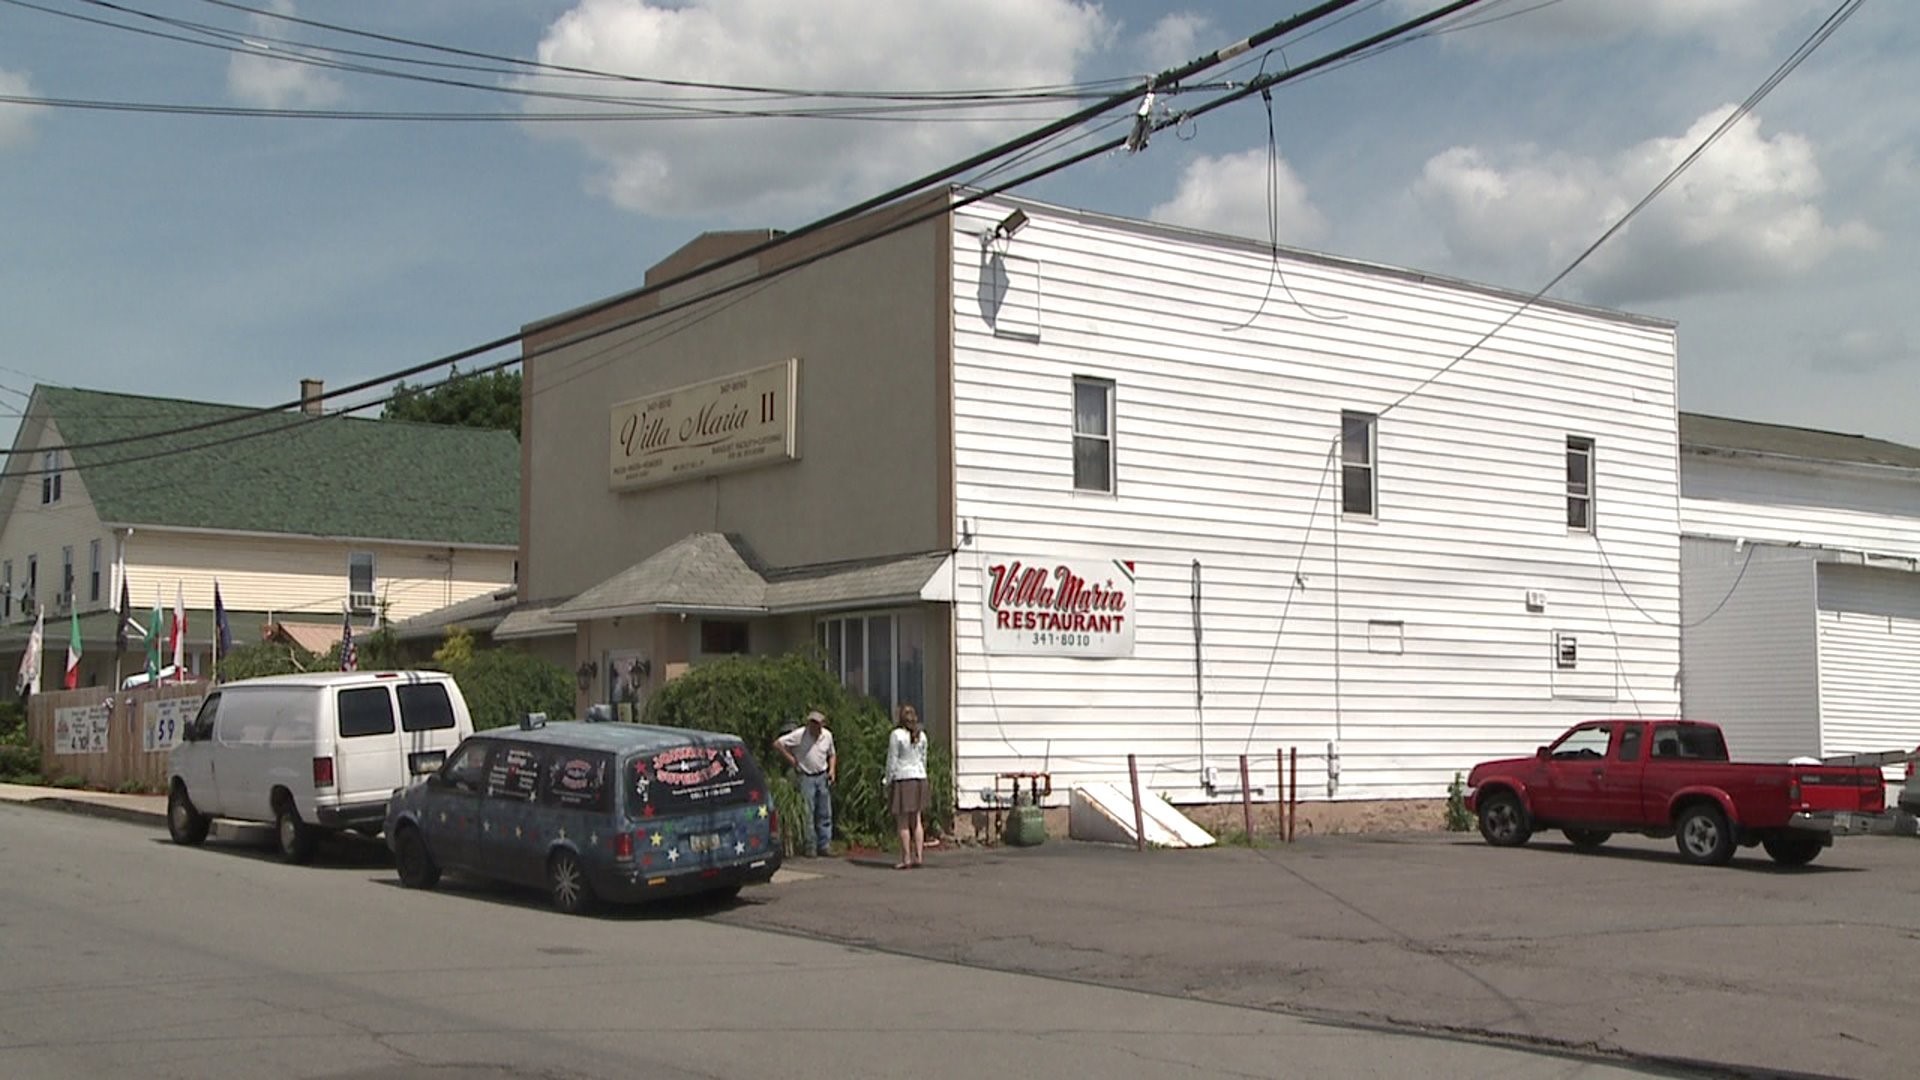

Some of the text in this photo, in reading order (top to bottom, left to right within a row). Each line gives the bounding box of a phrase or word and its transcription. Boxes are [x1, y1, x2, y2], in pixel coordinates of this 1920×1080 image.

[620, 412, 671, 456] Villa
[679, 400, 749, 441] Maria
[760, 391, 775, 423] II
[988, 561, 1126, 612] Villa Maria
[997, 610, 1125, 634] RESTAURANT
